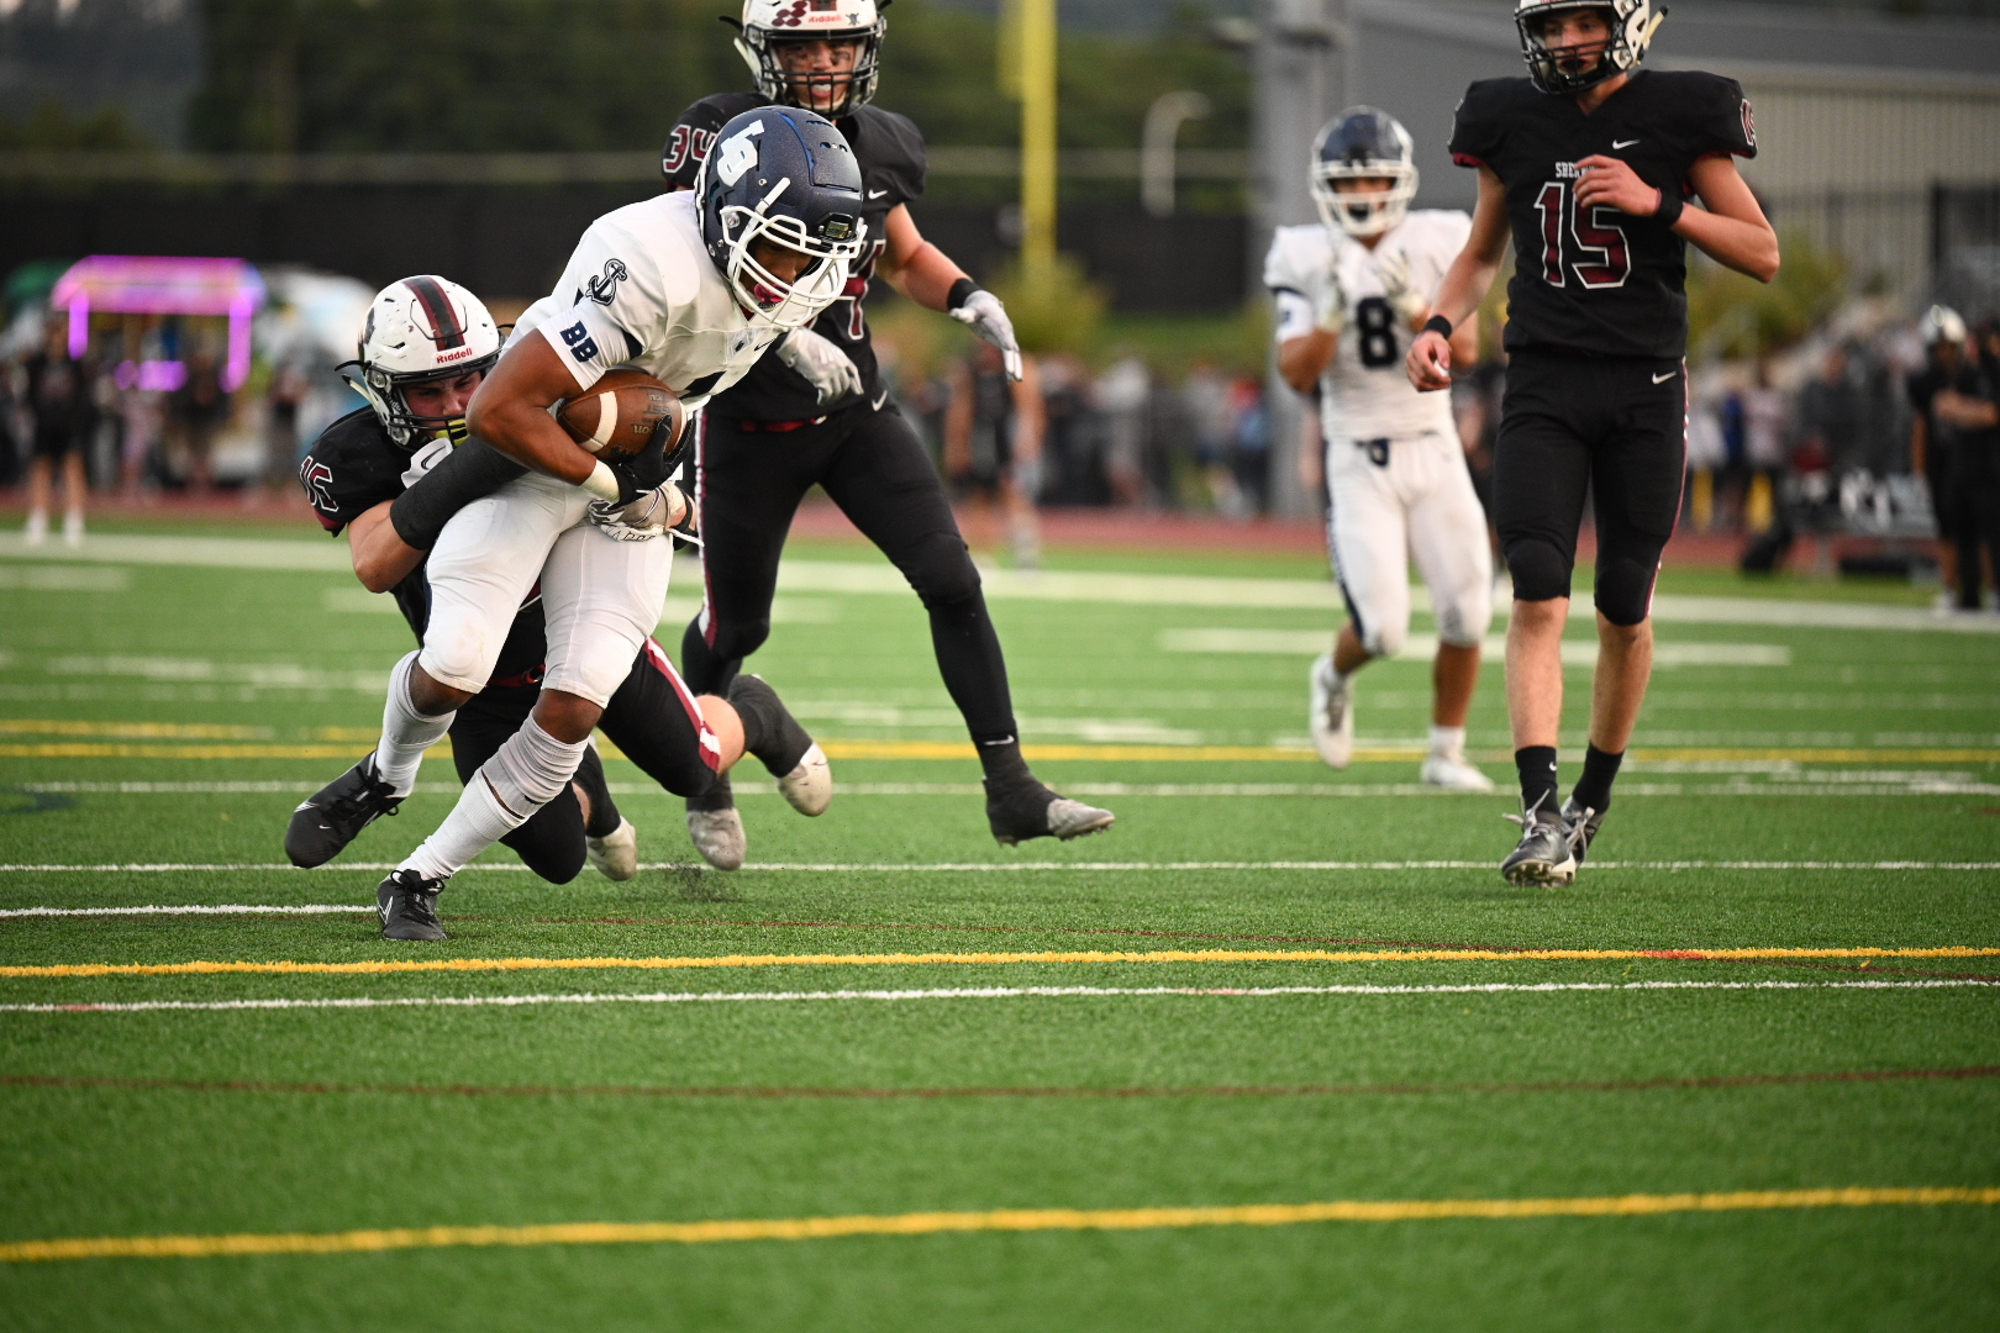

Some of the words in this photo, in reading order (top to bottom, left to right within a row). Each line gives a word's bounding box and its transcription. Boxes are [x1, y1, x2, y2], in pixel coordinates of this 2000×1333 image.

[662, 124, 719, 174] 34
[1533, 181, 1631, 289] 15
[436, 347, 473, 364] Riddell
[559, 320, 599, 363] BB
[1356, 297, 1399, 369] 8
